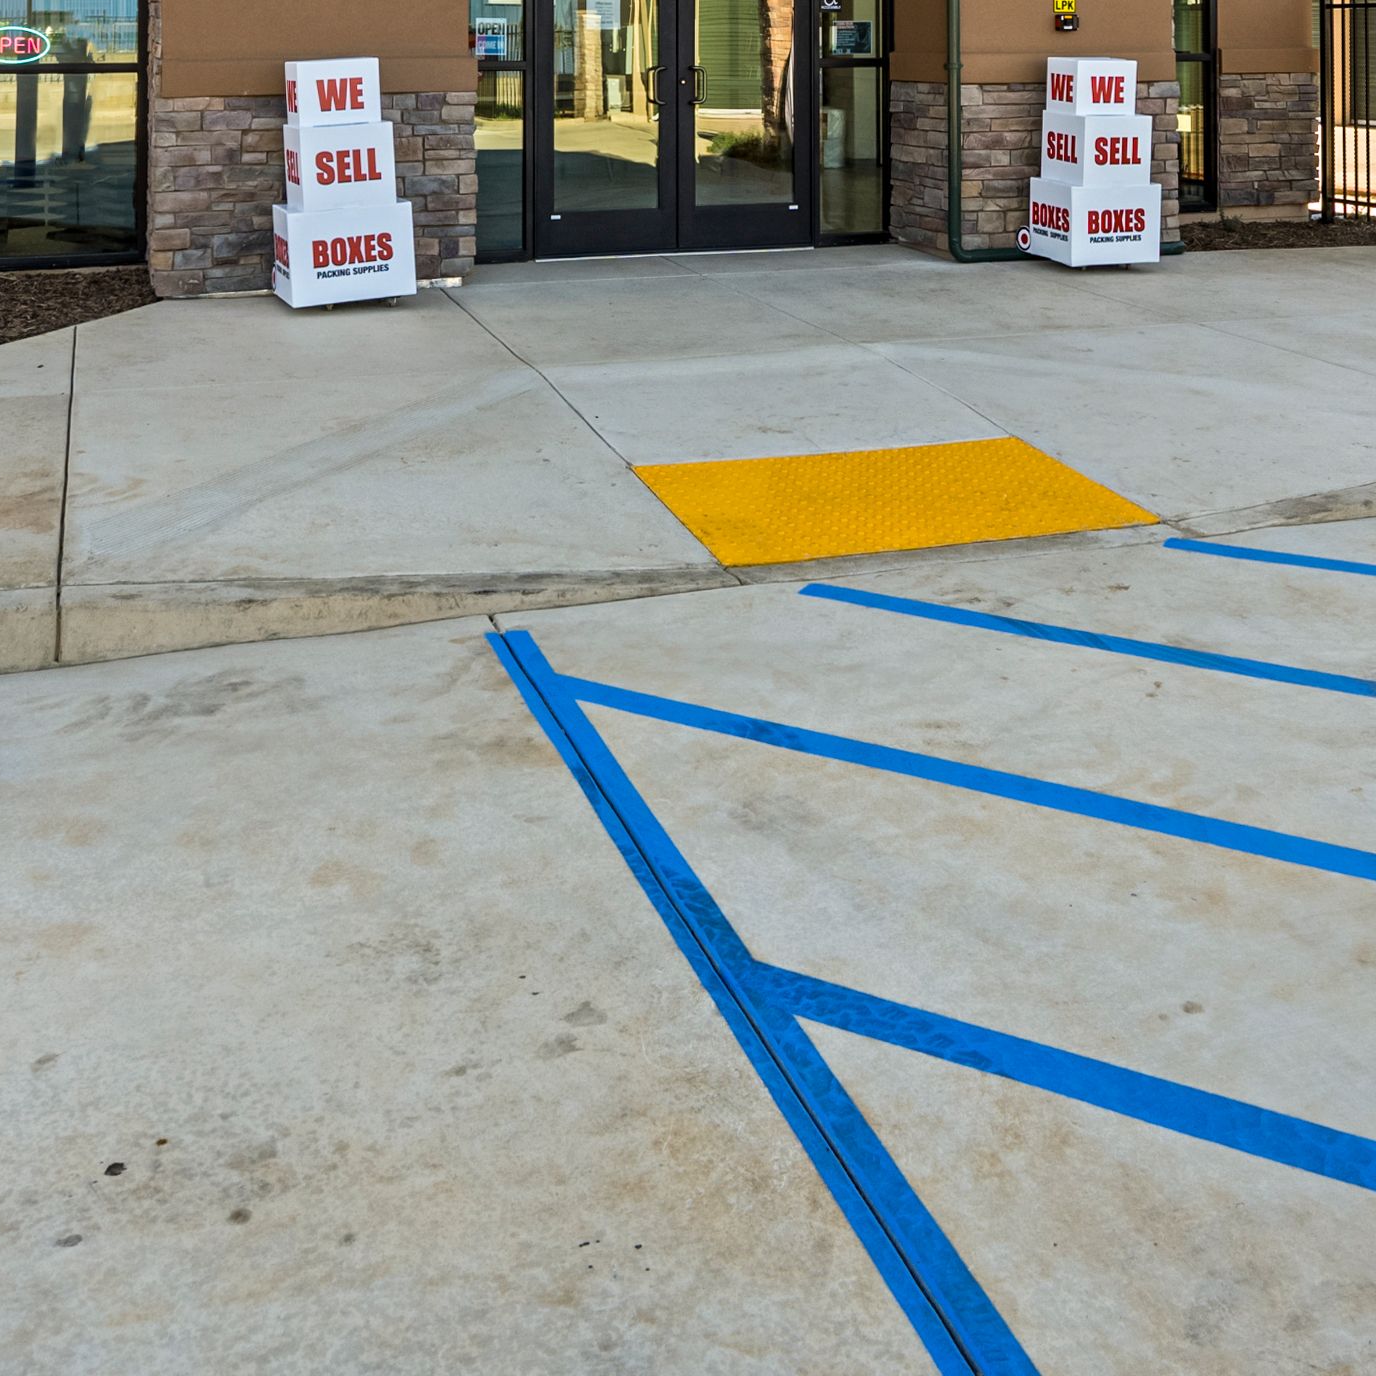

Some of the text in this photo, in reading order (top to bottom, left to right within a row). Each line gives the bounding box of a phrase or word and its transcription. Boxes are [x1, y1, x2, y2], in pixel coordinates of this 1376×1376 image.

[1055, 0, 1074, 10] LPK
[478, 22, 505, 35] OPEN
[286, 79, 298, 114] WE
[316, 77, 365, 112] WE
[1050, 72, 1074, 103] WE
[1091, 76, 1125, 104] WE
[1047, 131, 1078, 165] SELL
[1094, 137, 1142, 166] SELL
[286, 149, 300, 186] SELL
[315, 147, 382, 186] SELL
[1032, 201, 1070, 233] BOXES
[1087, 208, 1146, 235] BOXES
[1032, 227, 1069, 242] PACKING SUPPLIES
[1089, 234, 1142, 244] PACKING SUPPLIES
[312, 232, 394, 270] BOXES
[316, 264, 390, 280] PACKING SUPPLIES
